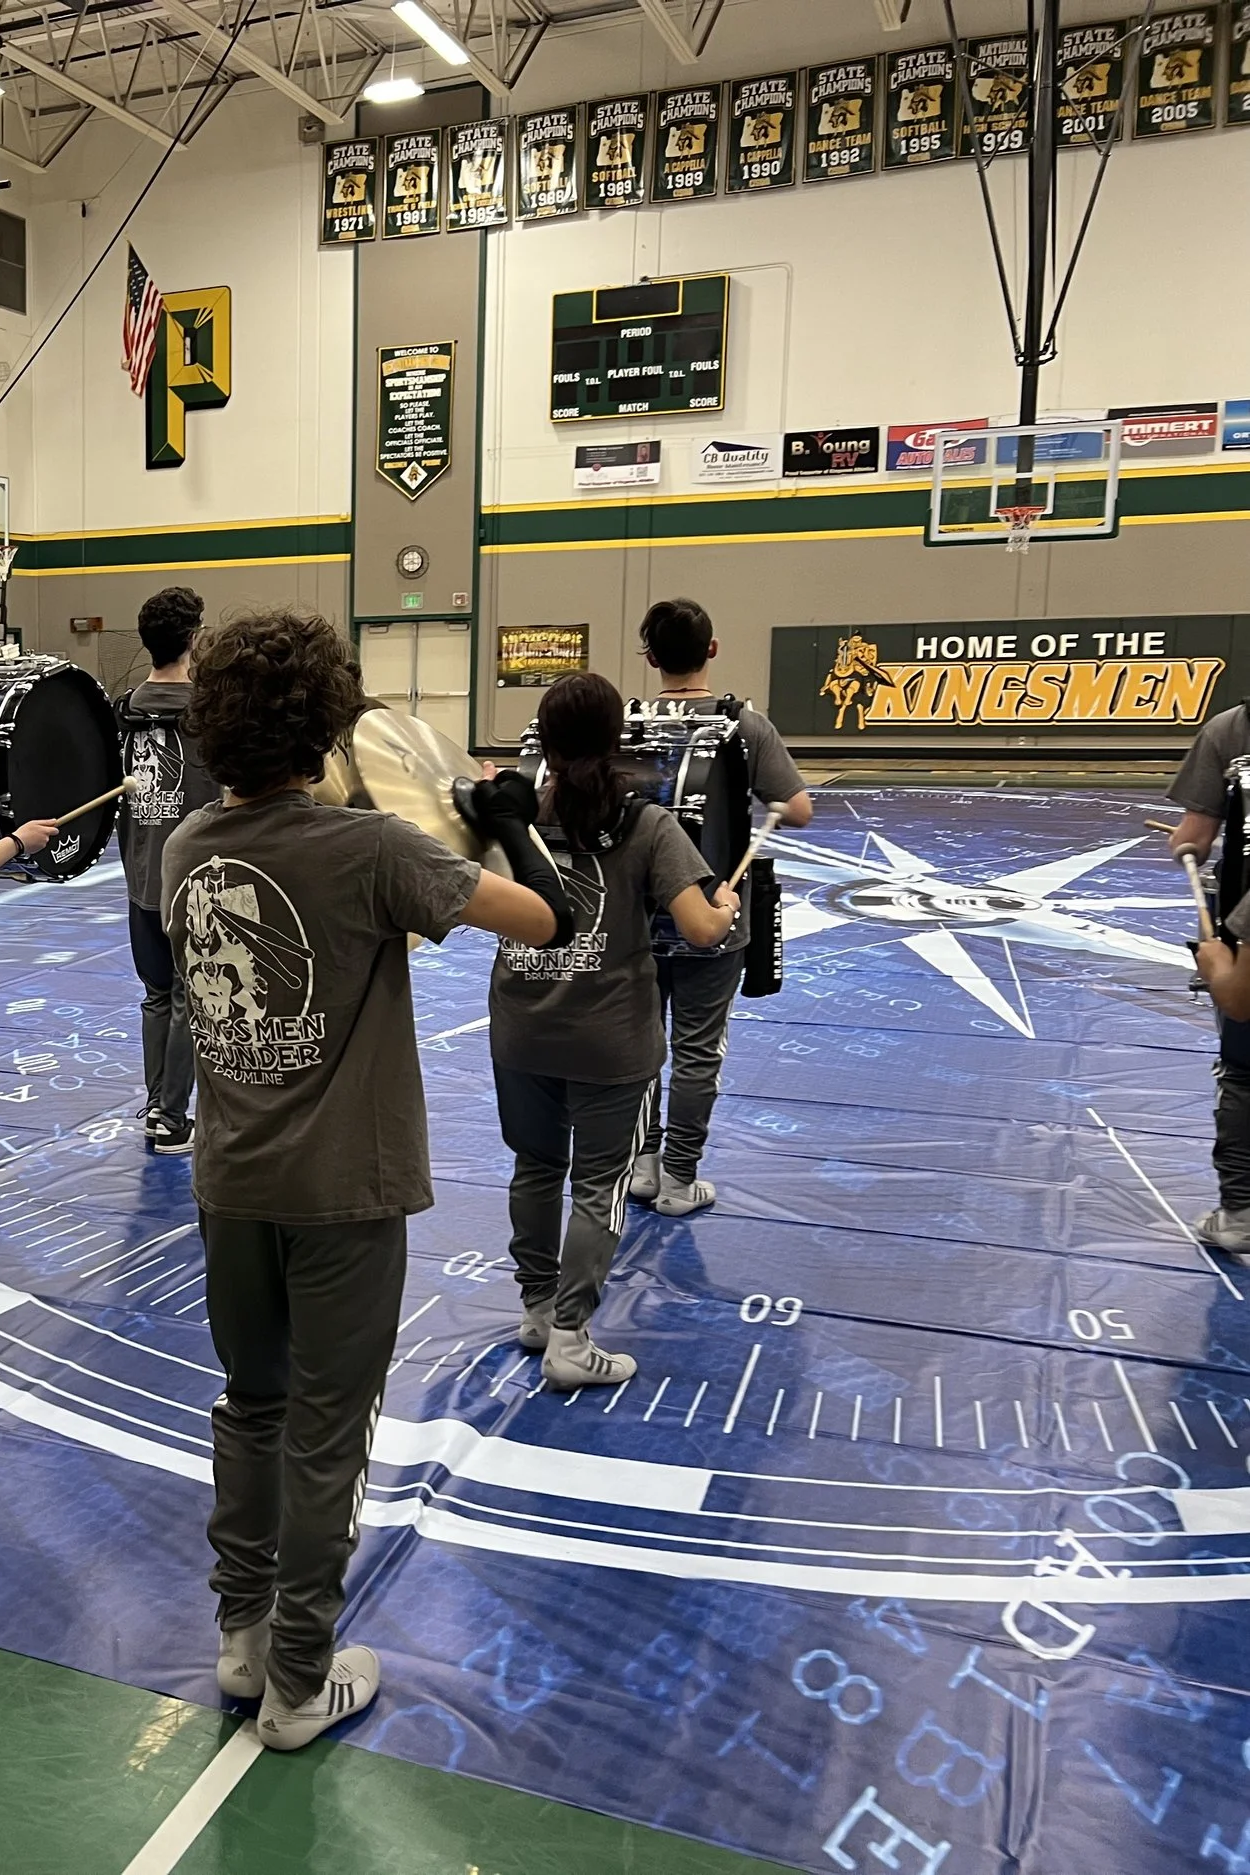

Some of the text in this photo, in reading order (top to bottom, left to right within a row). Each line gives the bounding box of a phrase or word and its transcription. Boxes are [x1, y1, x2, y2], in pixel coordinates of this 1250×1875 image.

[1151, 13, 1206, 34] STATE
[1064, 28, 1115, 47] STATE
[897, 51, 946, 71] STATE
[970, 53, 1028, 77] CHAMPION
[818, 65, 865, 85] STATE
[890, 63, 953, 90] CHAMPIONS
[741, 80, 786, 97] STATE
[811, 78, 872, 104] CHAMPIONS
[667, 92, 710, 109] STATE
[734, 92, 793, 116] CHAMPIONS
[597, 102, 638, 119] STATE
[660, 104, 716, 127] CHAMPIONS
[1056, 103, 1087, 118] ANCE
[1151, 101, 1199, 123] 2005
[527, 114, 567, 131] STATE
[590, 113, 644, 136] CHAMPIONS
[892, 120, 948, 139] SOFTBALL
[1062, 114, 1105, 135] 2001
[394, 137, 432, 152] STATE
[458, 127, 497, 143] STATE
[521, 125, 574, 149] CHAMPIONS
[808, 133, 872, 153] DANCE TEAM
[900, 134, 941, 155] 1995
[970, 129, 1023, 153] 999
[333, 144, 369, 159] STATE
[388, 148, 437, 169] CHAMPIONS
[820, 147, 860, 168] 1992
[328, 155, 374, 175] CHAMPIONS
[592, 167, 636, 182] SOFTBALL
[742, 161, 781, 180] 1990
[523, 176, 569, 194] SOFTLL
[599, 180, 632, 197] 1989
[666, 171, 703, 189] 1989
[334, 216, 364, 232] 1971
[396, 209, 427, 226] 1981
[620, 326, 652, 338] PERIOD
[394, 347, 428, 356] WELCOME
[607, 365, 664, 378] PLAYER FOUL
[690, 360, 719, 371] FOULS
[553, 373, 580, 383] FOULS
[618, 402, 649, 413] MATCH
[689, 397, 718, 408] SCORE
[553, 408, 579, 418] SCORE
[388, 426, 416, 434] COACHES
[1122, 420, 1214, 435] MMERT
[704, 450, 769, 464] CB Quality
[791, 441, 810, 455] B.
[896, 450, 935, 466] AUTO
[943, 447, 976, 462] ALES
[832, 452, 859, 468] RV
[916, 631, 1165, 661] HOME OF THE
[865, 658, 1226, 727] KINGSMEN
[56, 843, 78, 860] REMO
[502, 951, 602, 972] THUNDER
[196, 1034, 323, 1072] THUNDER
[213, 1065, 285, 1085] DRUMLINE
[739, 1293, 803, 1328] 60
[1069, 1307, 1135, 1342] 50
